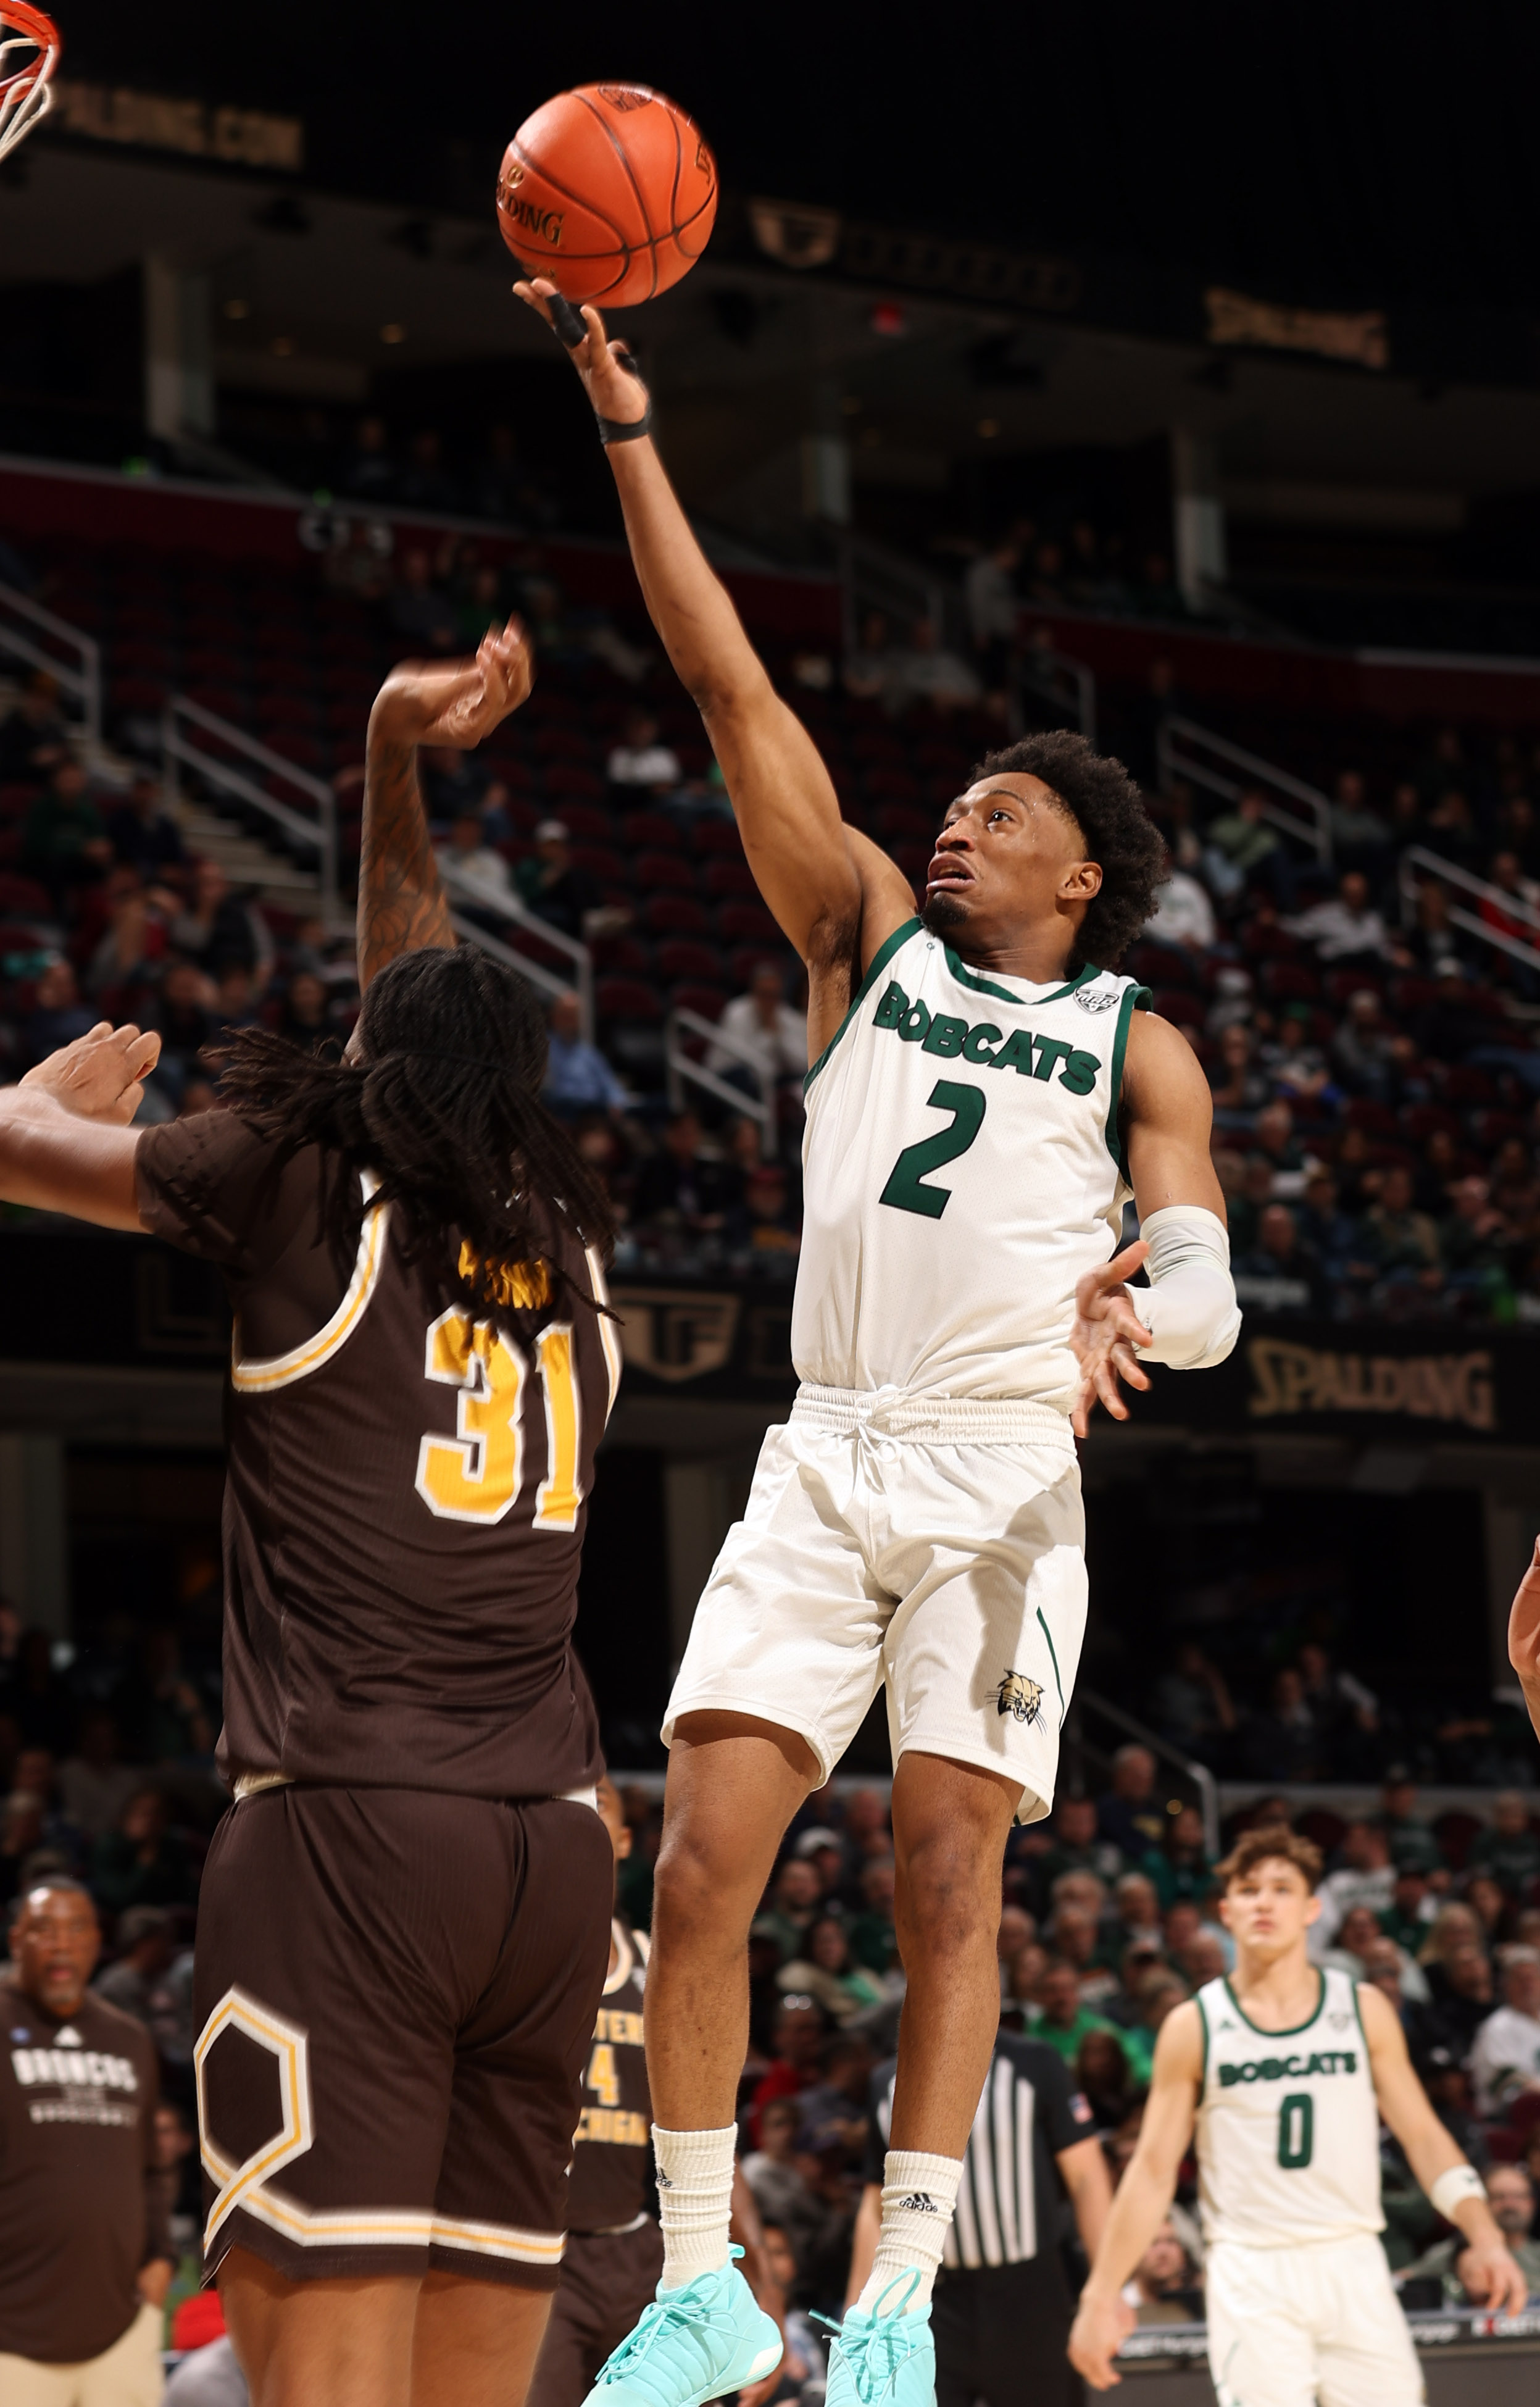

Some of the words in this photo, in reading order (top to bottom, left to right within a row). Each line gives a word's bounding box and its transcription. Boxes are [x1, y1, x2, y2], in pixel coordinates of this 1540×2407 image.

[872, 980, 1102, 1096] BOBCATS
[878, 1079, 987, 1220] 2
[414, 1301, 585, 1533] 31
[1249, 1338, 1495, 1430] SPALDING
[588, 2043, 620, 2108] 4
[1218, 2052, 1357, 2088] BOBCATS
[1277, 2092, 1313, 2169] 0
[899, 2199, 938, 2213] adidas
